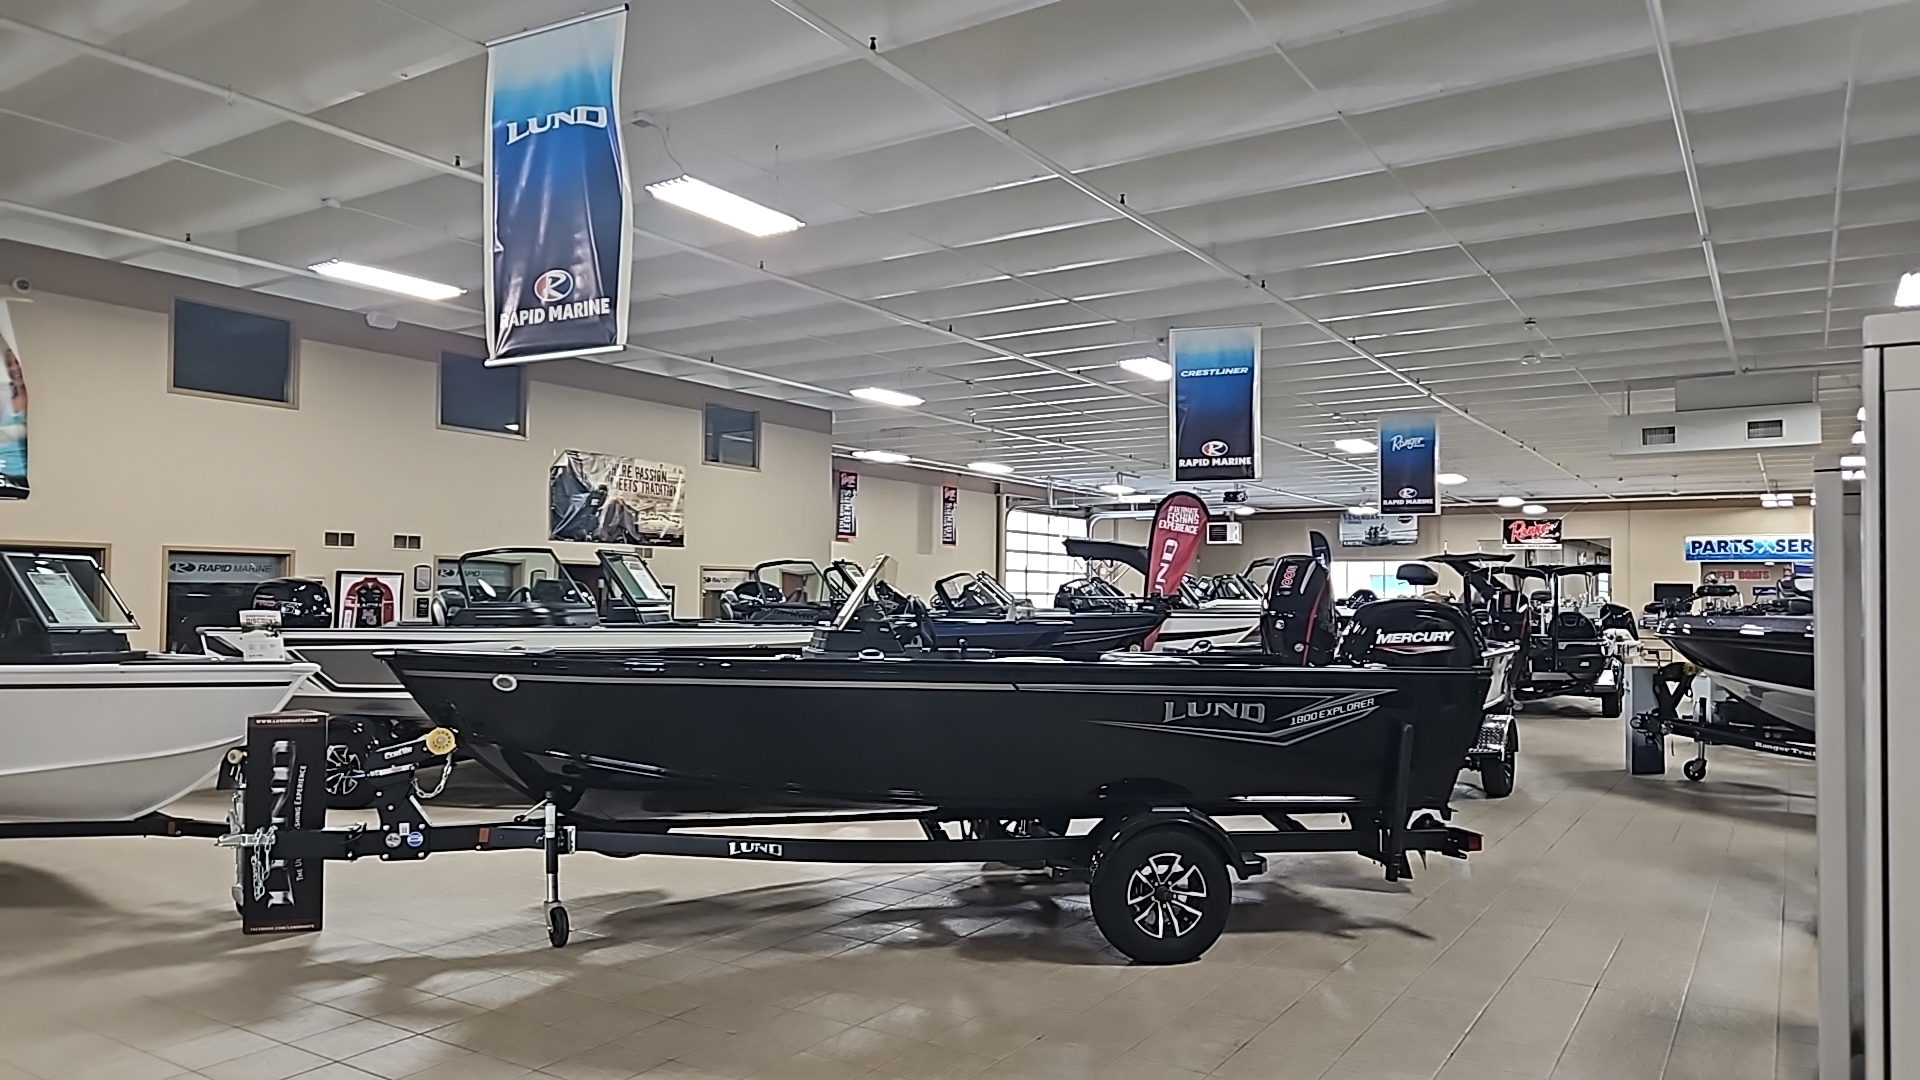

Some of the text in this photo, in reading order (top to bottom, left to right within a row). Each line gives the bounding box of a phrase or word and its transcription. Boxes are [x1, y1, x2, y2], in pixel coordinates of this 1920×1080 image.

[506, 105, 608, 146] LUND
[499, 298, 610, 328] RAPID MARINE
[1180, 367, 1249, 377] CRESTLINER
[1179, 457, 1252, 467] RAPID MARINE
[604, 461, 667, 483] HRE PASSION
[1167, 512, 1199, 525] FISHING
[1159, 520, 1199, 535] EXPERIENCE
[1690, 539, 1754, 554] PARTS
[198, 563, 232, 572] RAPID
[233, 564, 272, 573] MARINE
[1376, 630, 1455, 645] MERCURY
[1162, 701, 1266, 723] LUND
[1289, 698, 1375, 726] 1800 EXPLORER
[1754, 741, 1790, 753] Ranger
[728, 841, 783, 857] LUND
